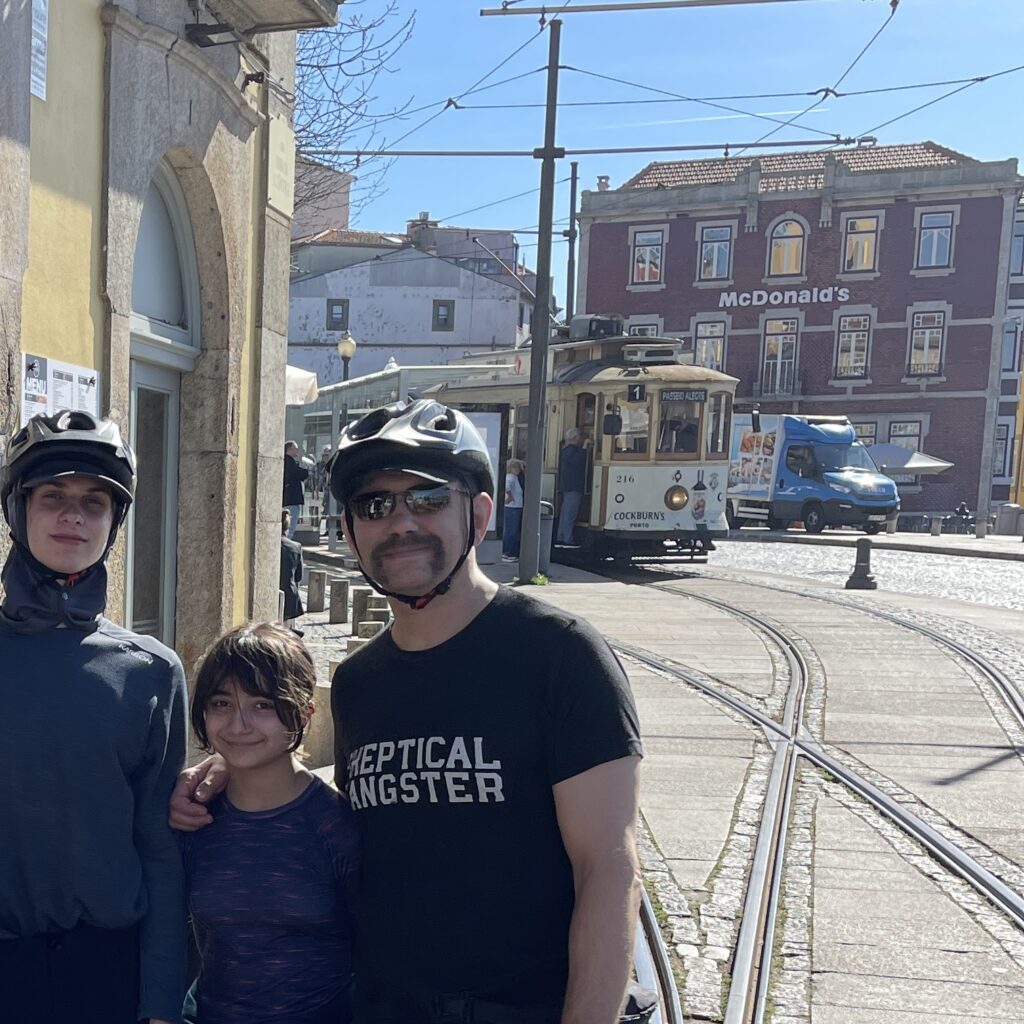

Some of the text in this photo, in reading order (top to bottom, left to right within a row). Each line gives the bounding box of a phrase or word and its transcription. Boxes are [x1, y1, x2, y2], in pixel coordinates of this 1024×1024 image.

[718, 286, 850, 308] McDonald's
[25, 376, 47, 395] MENU
[633, 385, 640, 400] 1
[616, 474, 635, 483] 216
[614, 511, 665, 521] COCKBURN'S
[347, 736, 502, 779] KEPTICAL
[346, 771, 505, 812] ANGSTER
